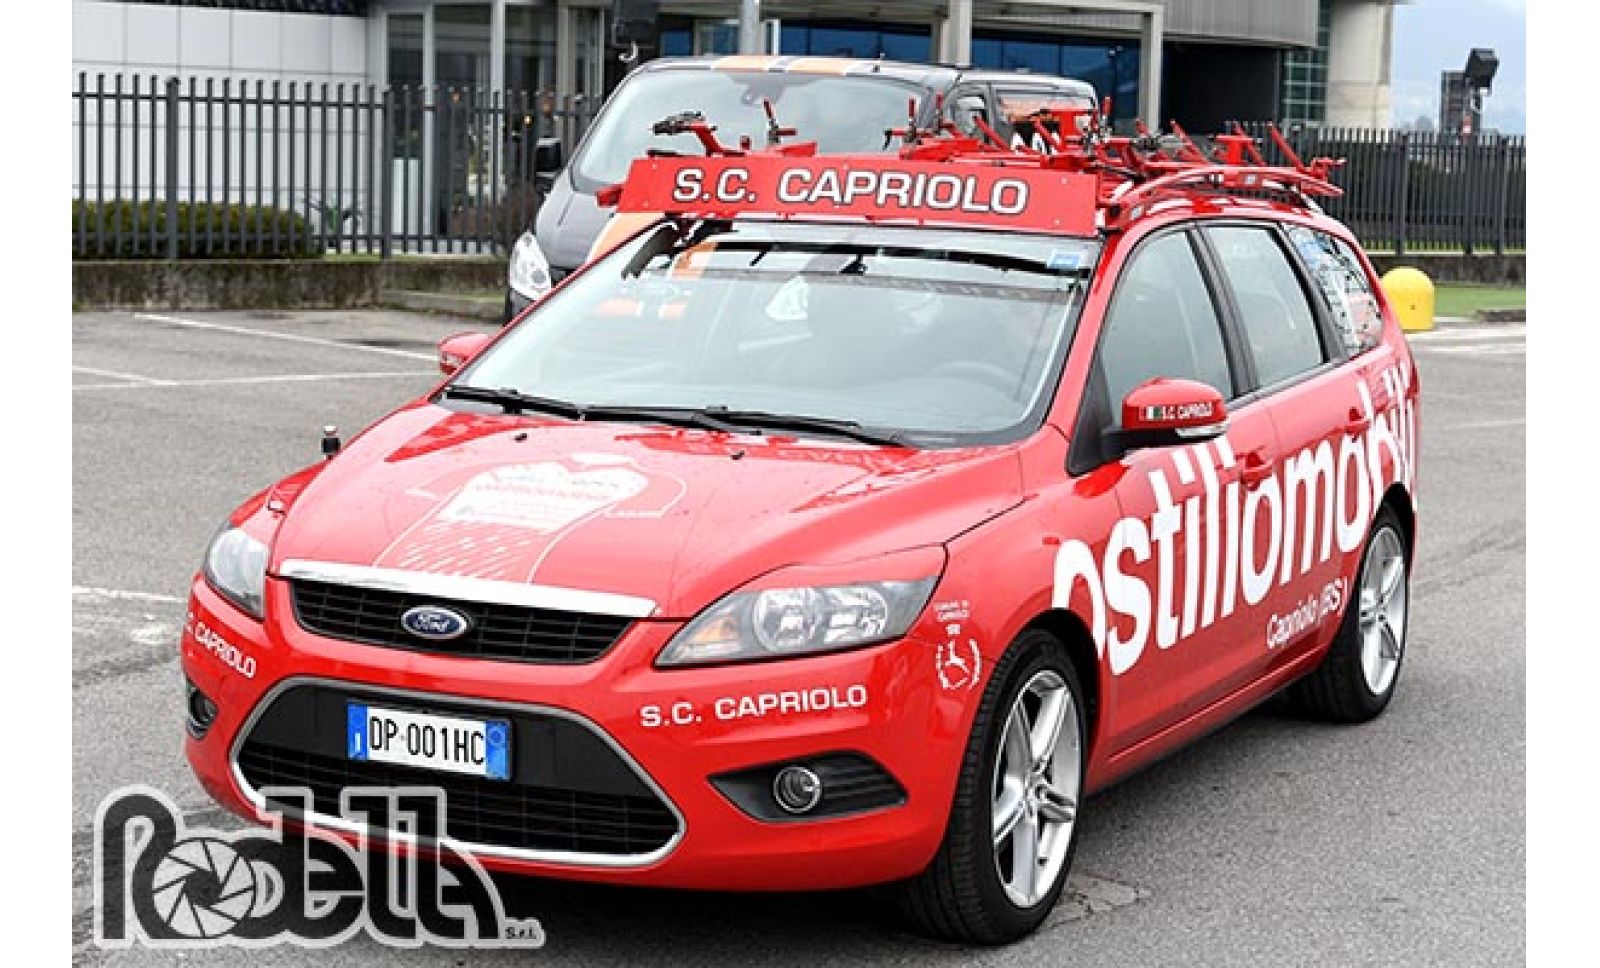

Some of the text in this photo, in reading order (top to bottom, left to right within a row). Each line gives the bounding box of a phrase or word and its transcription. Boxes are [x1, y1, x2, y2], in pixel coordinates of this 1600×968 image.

[672, 167, 1029, 215] S.C. CAPRIOLO
[194, 621, 257, 679] CAPRIOLO
[640, 684, 868, 728] S.C. CAPRIOLO
